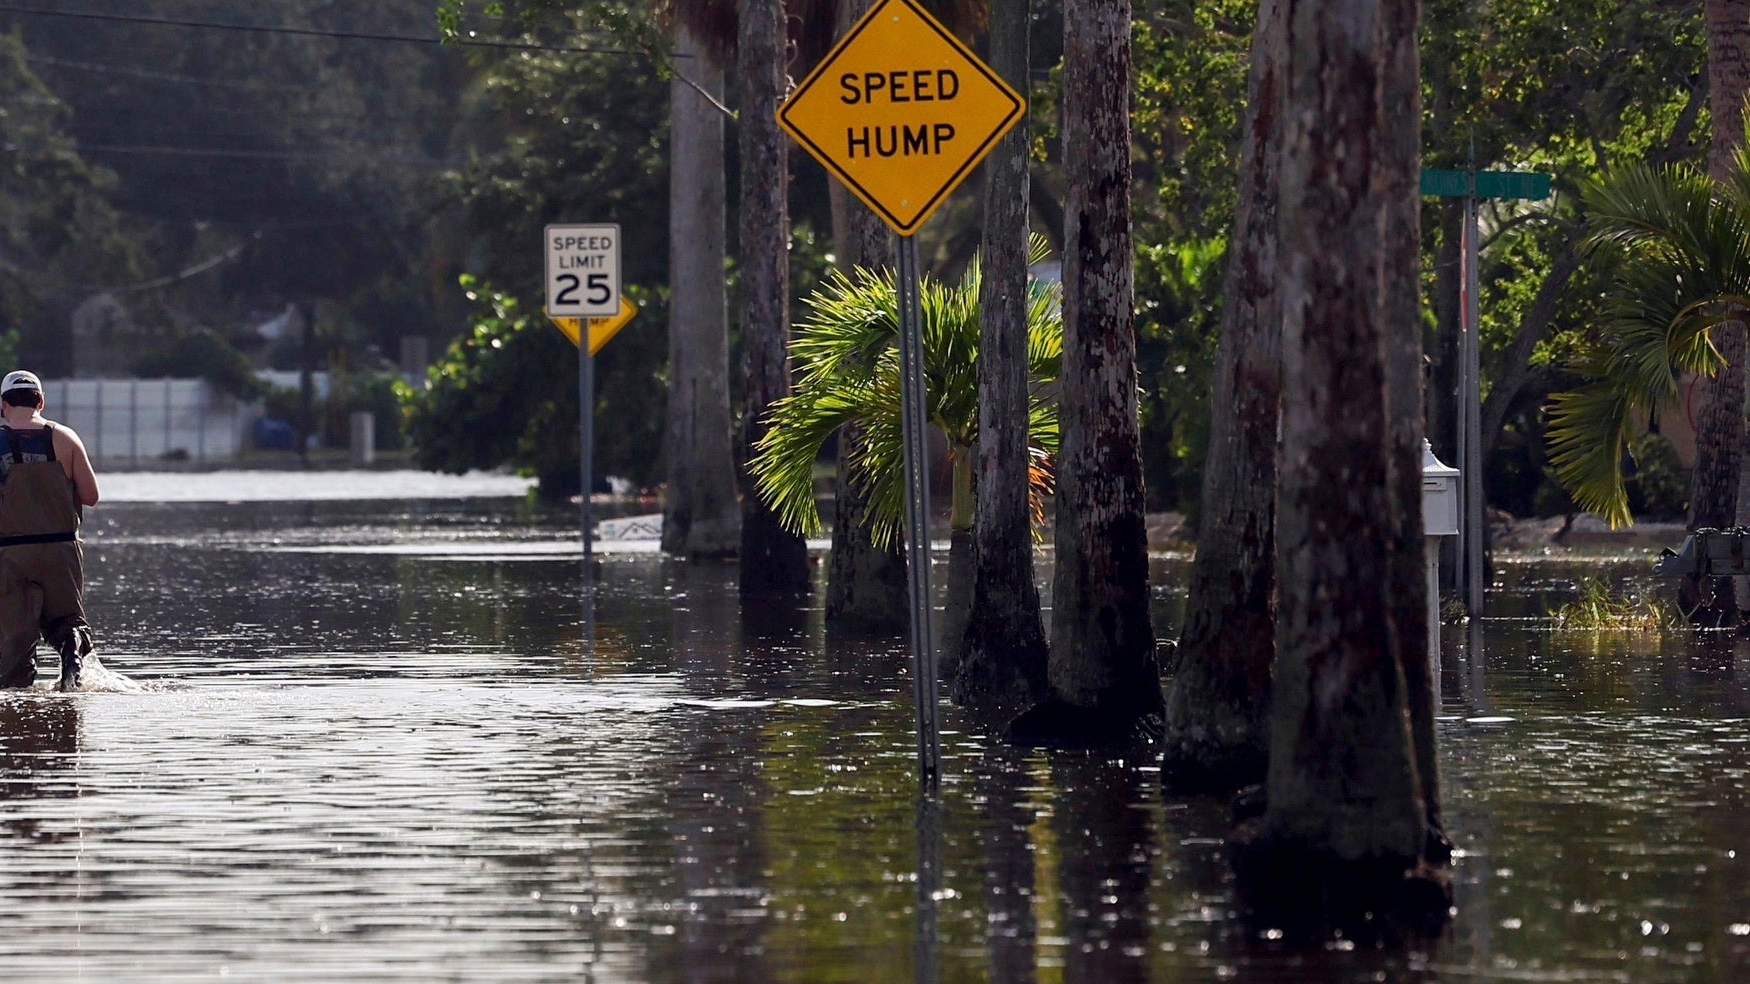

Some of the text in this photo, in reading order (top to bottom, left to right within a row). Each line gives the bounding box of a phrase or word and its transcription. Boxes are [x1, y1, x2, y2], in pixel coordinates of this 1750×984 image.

[840, 69, 959, 104] SPEED
[847, 123, 956, 158] HUMP
[553, 237, 612, 251] SPEED
[559, 255, 606, 269] LIMIT
[555, 274, 611, 305] 25
